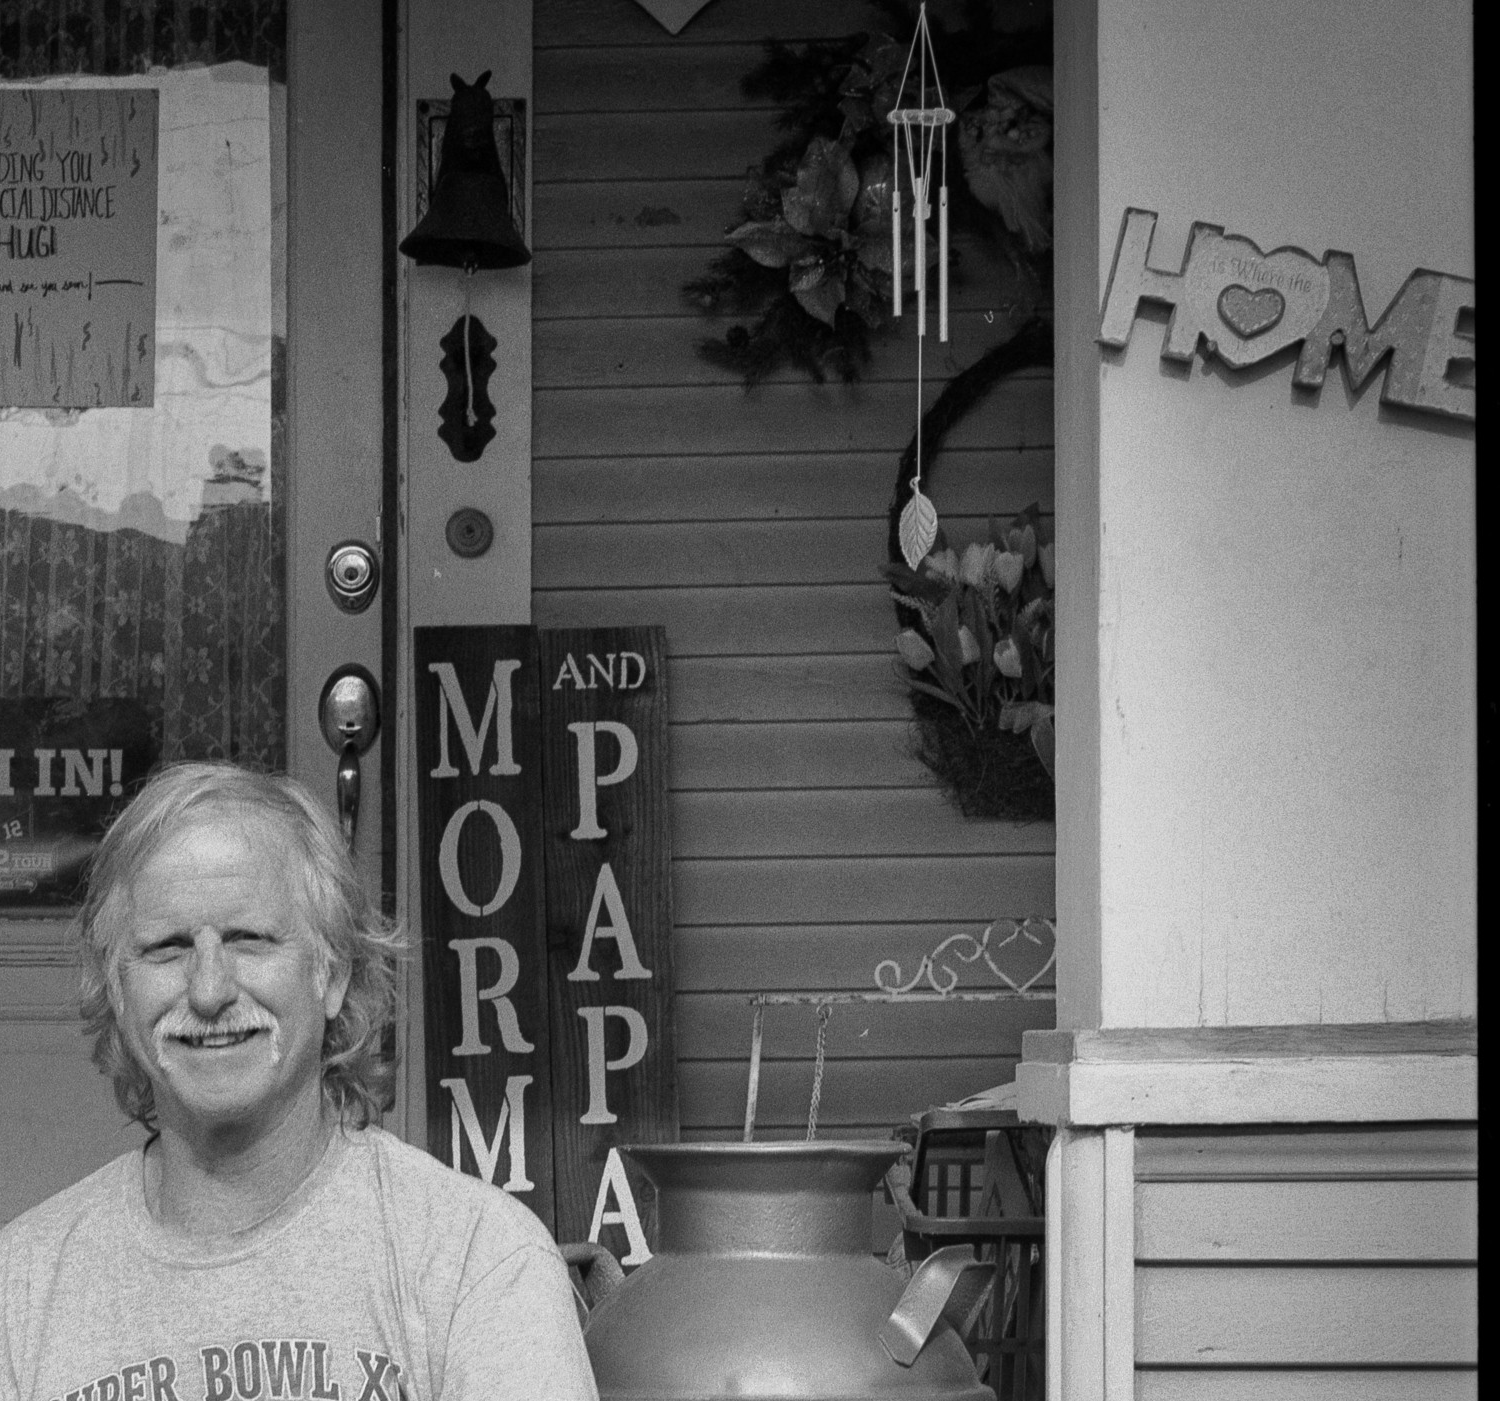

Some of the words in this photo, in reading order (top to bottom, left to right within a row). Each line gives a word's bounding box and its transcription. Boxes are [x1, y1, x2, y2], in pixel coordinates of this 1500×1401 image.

[56, 149, 93, 183] YOU
[40, 185, 116, 222] DISTANCE
[553, 651, 647, 691] AND
[33, 748, 124, 798] IN!
[2, 819, 24, 841] 12
[566, 719, 655, 1266] PAPA
